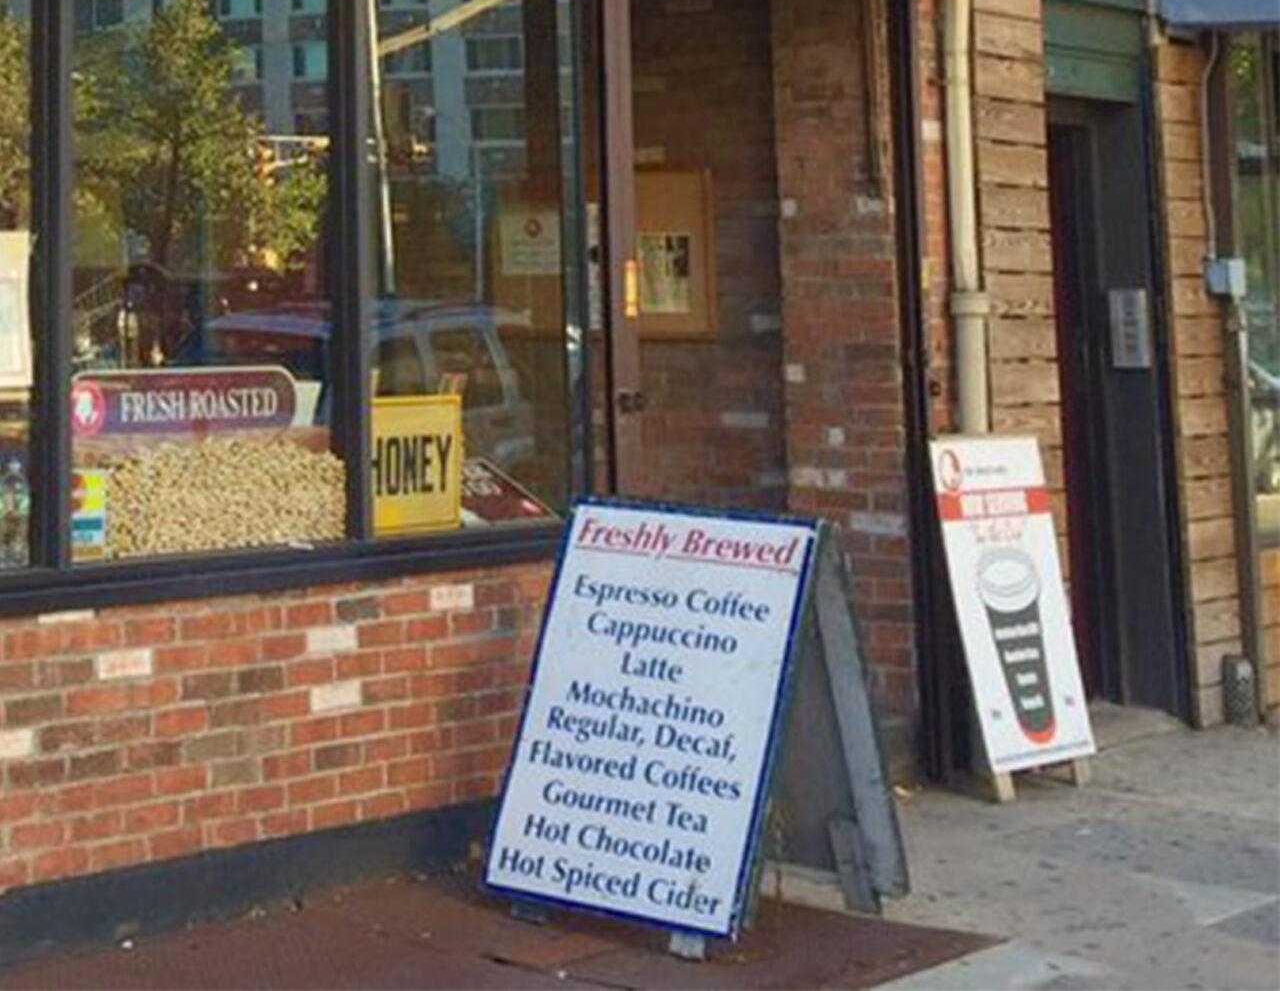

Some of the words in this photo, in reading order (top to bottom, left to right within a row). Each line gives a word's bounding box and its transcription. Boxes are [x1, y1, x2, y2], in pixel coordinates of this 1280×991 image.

[120, 389, 185, 422] FRESH
[189, 387, 278, 419] ROASTED
[577, 517, 675, 560] Freshly
[682, 528, 799, 565] Brewed
[574, 574, 678, 607] Espresso
[686, 588, 770, 622] Coffee
[587, 611, 738, 655] Cappuccino
[621, 652, 683, 683] Latte
[566, 680, 725, 728] Mochachino
[546, 705, 645, 748] Regular,
[654, 723, 737, 764] Decaf,
[528, 740, 637, 781] Flavored
[644, 759, 742, 801] Coffees
[543, 779, 656, 824] Gourmet
[665, 801, 709, 834] Tea
[523, 813, 570, 845] Hot
[577, 824, 712, 874] Chocolate
[498, 847, 546, 879] Hot
[551, 858, 641, 898] Spiced
[646, 876, 722, 916] Cider
